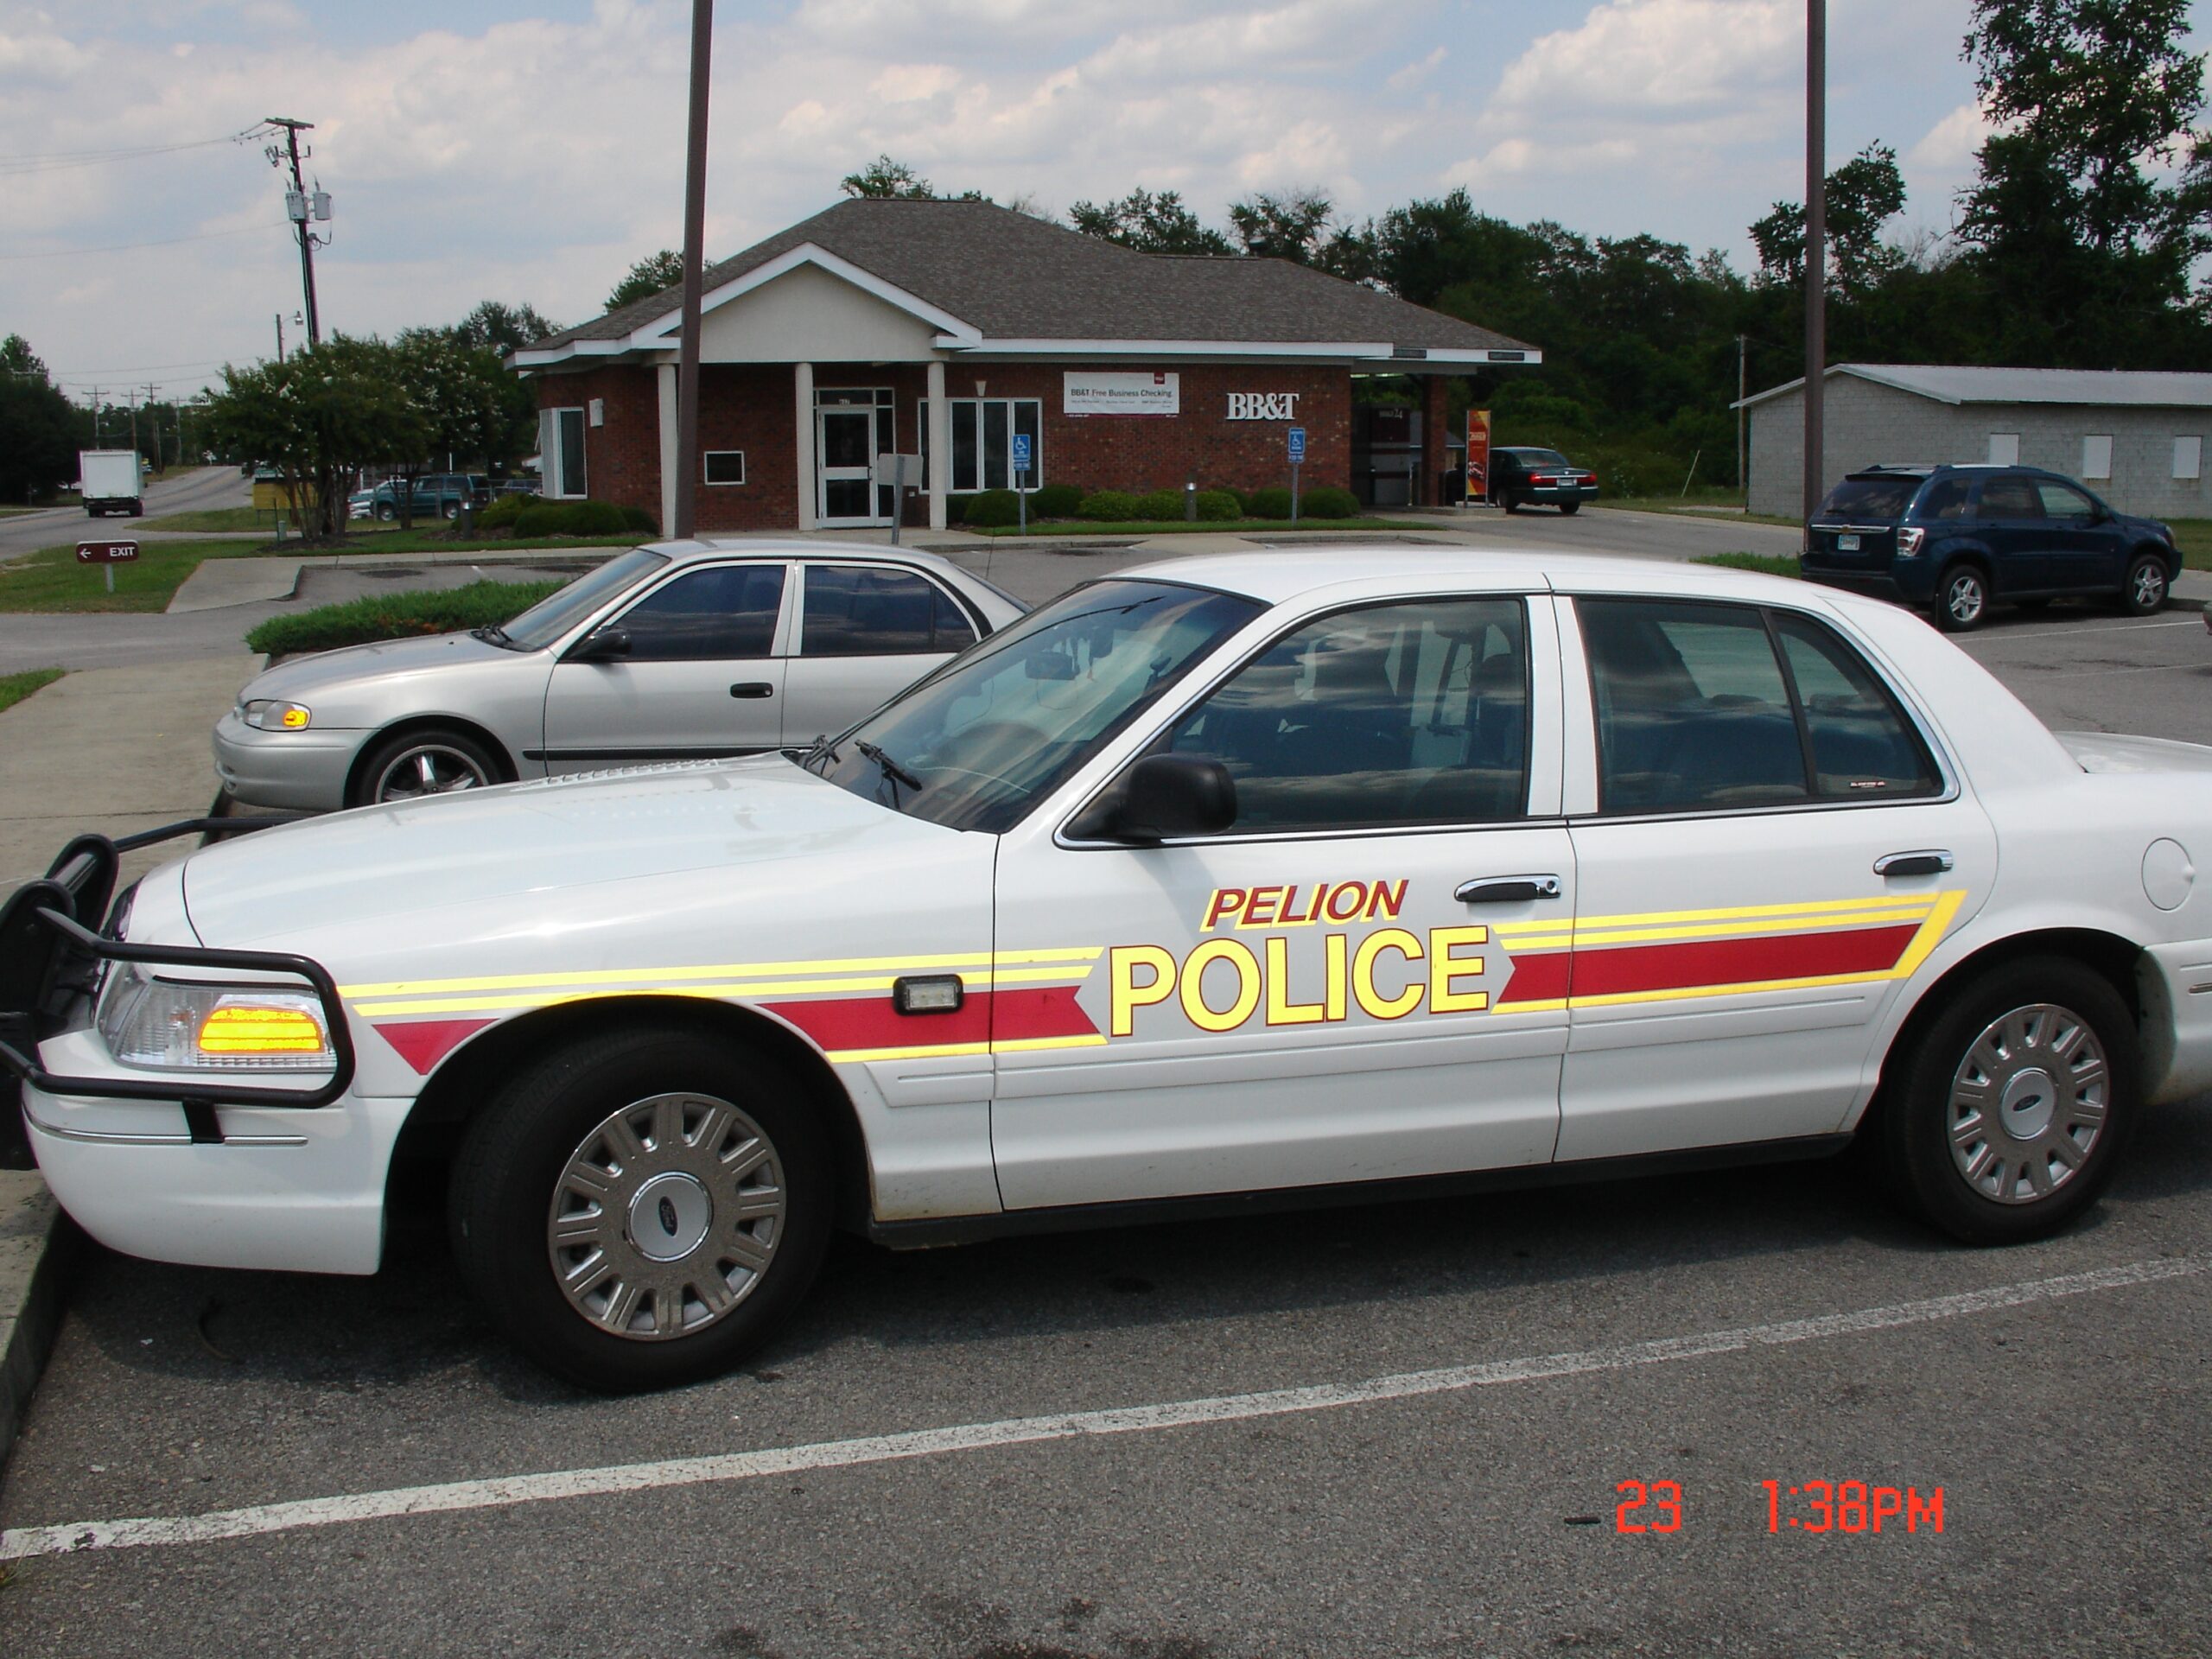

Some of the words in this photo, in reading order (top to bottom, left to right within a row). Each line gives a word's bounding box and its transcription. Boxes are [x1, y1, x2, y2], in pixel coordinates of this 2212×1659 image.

[1071, 388, 1090, 397] BB&T
[1109, 389, 1139, 397] Business
[1225, 392, 1300, 420] BB&T
[109, 546, 136, 557] EXIT
[1199, 879, 1409, 932] PELION
[1109, 925, 1490, 1038] POLICE
